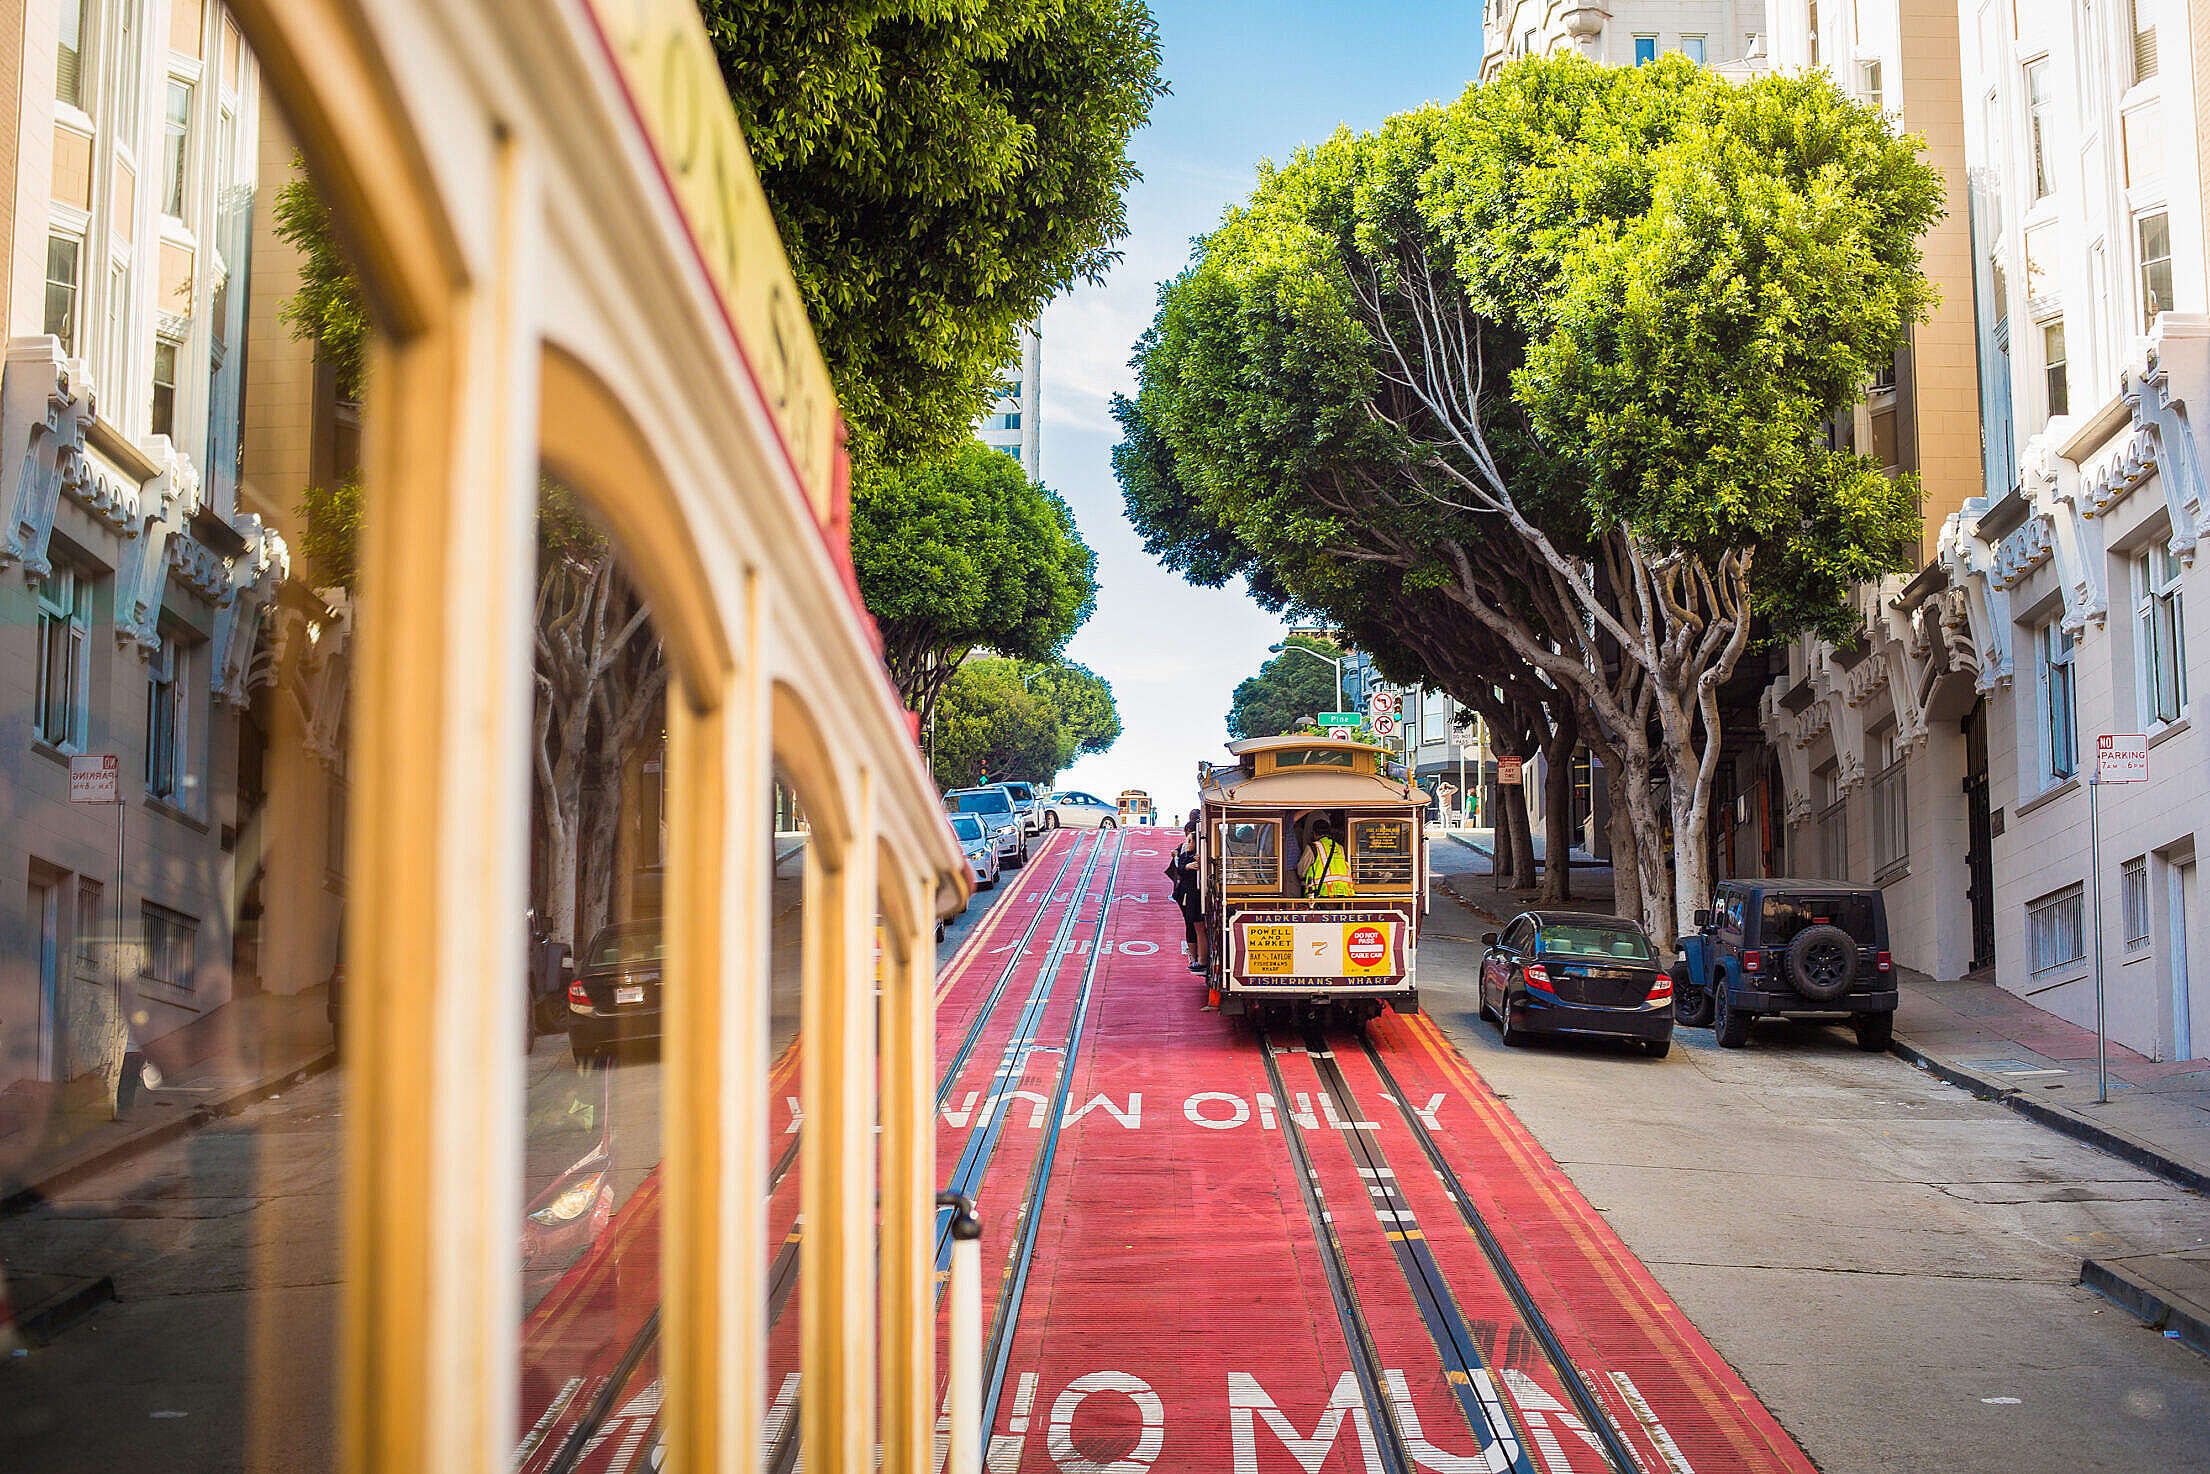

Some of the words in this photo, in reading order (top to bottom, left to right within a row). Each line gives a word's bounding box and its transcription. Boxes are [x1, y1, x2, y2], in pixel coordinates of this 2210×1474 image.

[1330, 715, 1349, 723] Pine
[2100, 737, 2111, 748] NO
[1255, 914, 1308, 922] MARKET
[1321, 914, 1372, 922] STREET
[1250, 928, 1291, 936] POWELL
[1248, 977, 1333, 986] FISHERMANS
[1347, 976, 1391, 985] WHARF
[938, 1090, 1142, 1130] MUN
[1183, 1091, 1448, 1131] ONLY
